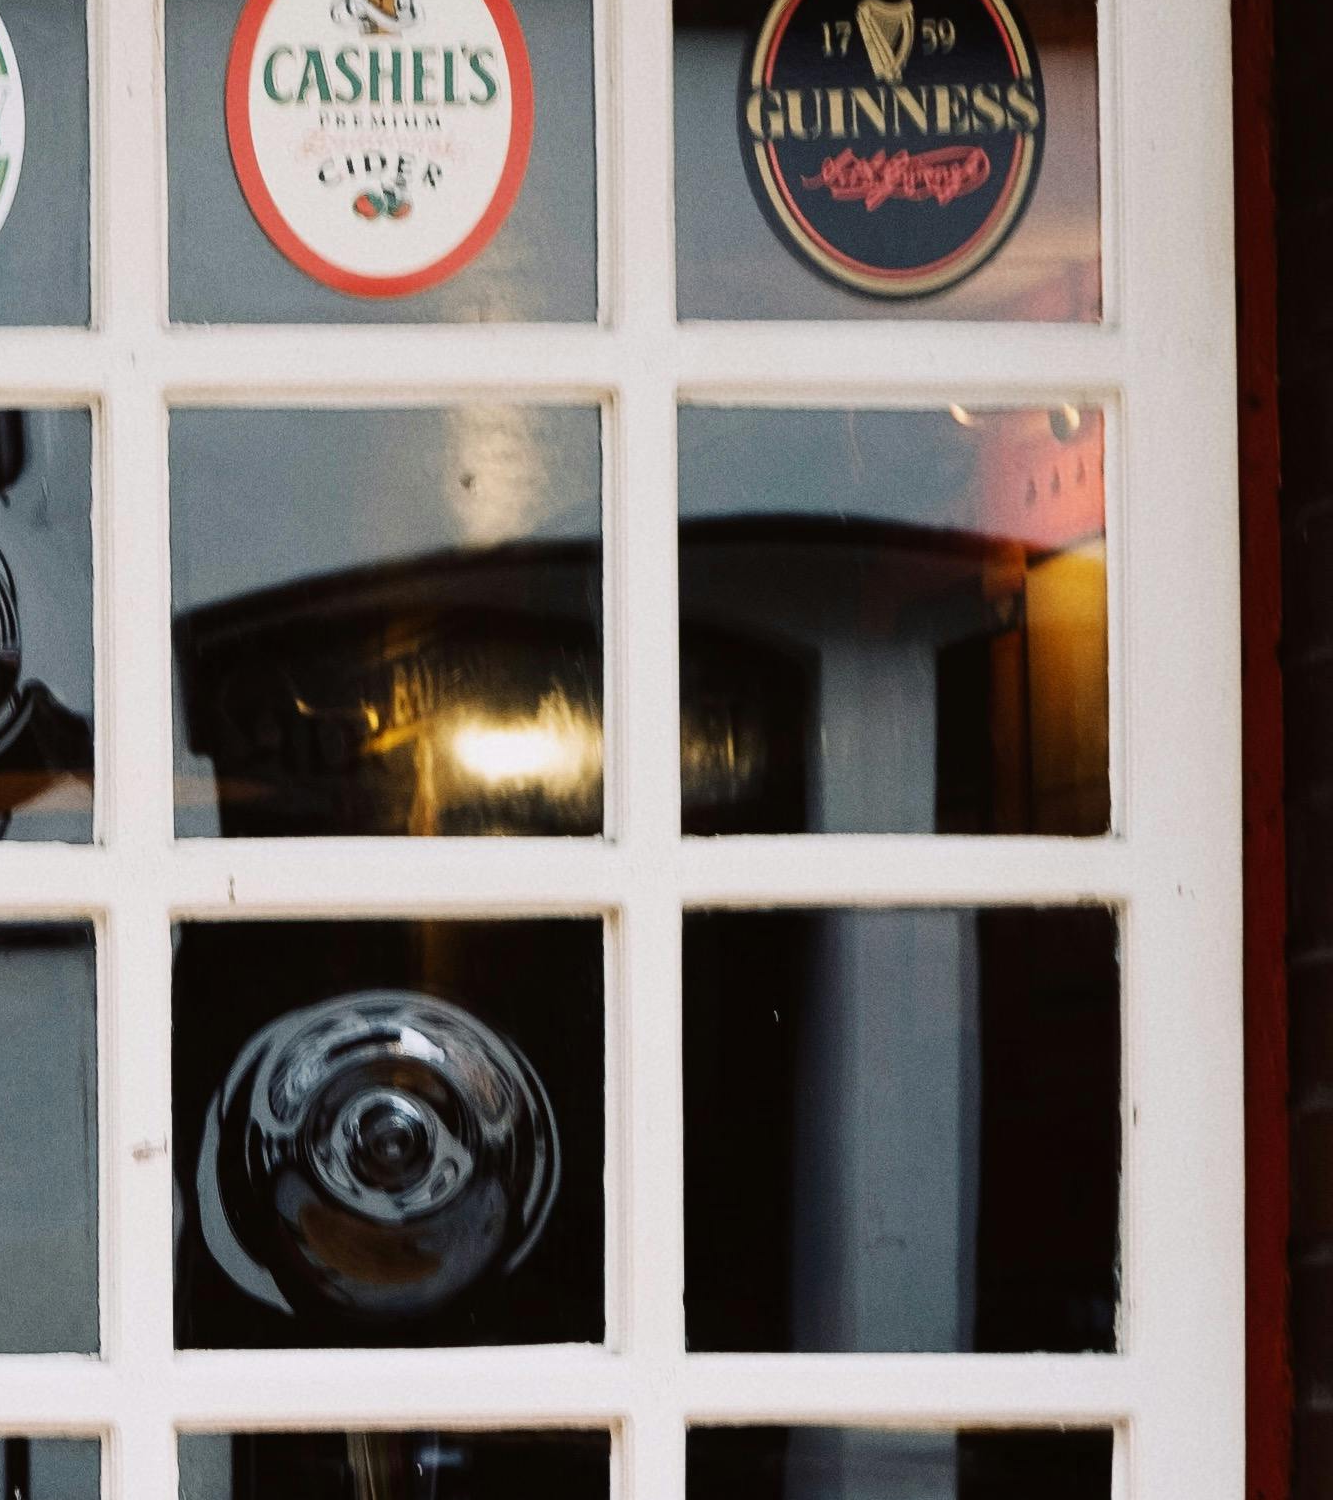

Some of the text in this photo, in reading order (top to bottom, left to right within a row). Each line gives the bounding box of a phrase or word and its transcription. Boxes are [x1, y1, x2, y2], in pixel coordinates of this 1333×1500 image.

[821, 20, 852, 57] 17
[922, 18, 956, 54] 59
[262, 43, 499, 106] CASHEL'S
[745, 82, 1040, 141] GUINNESS
[317, 153, 443, 188] CIDER
